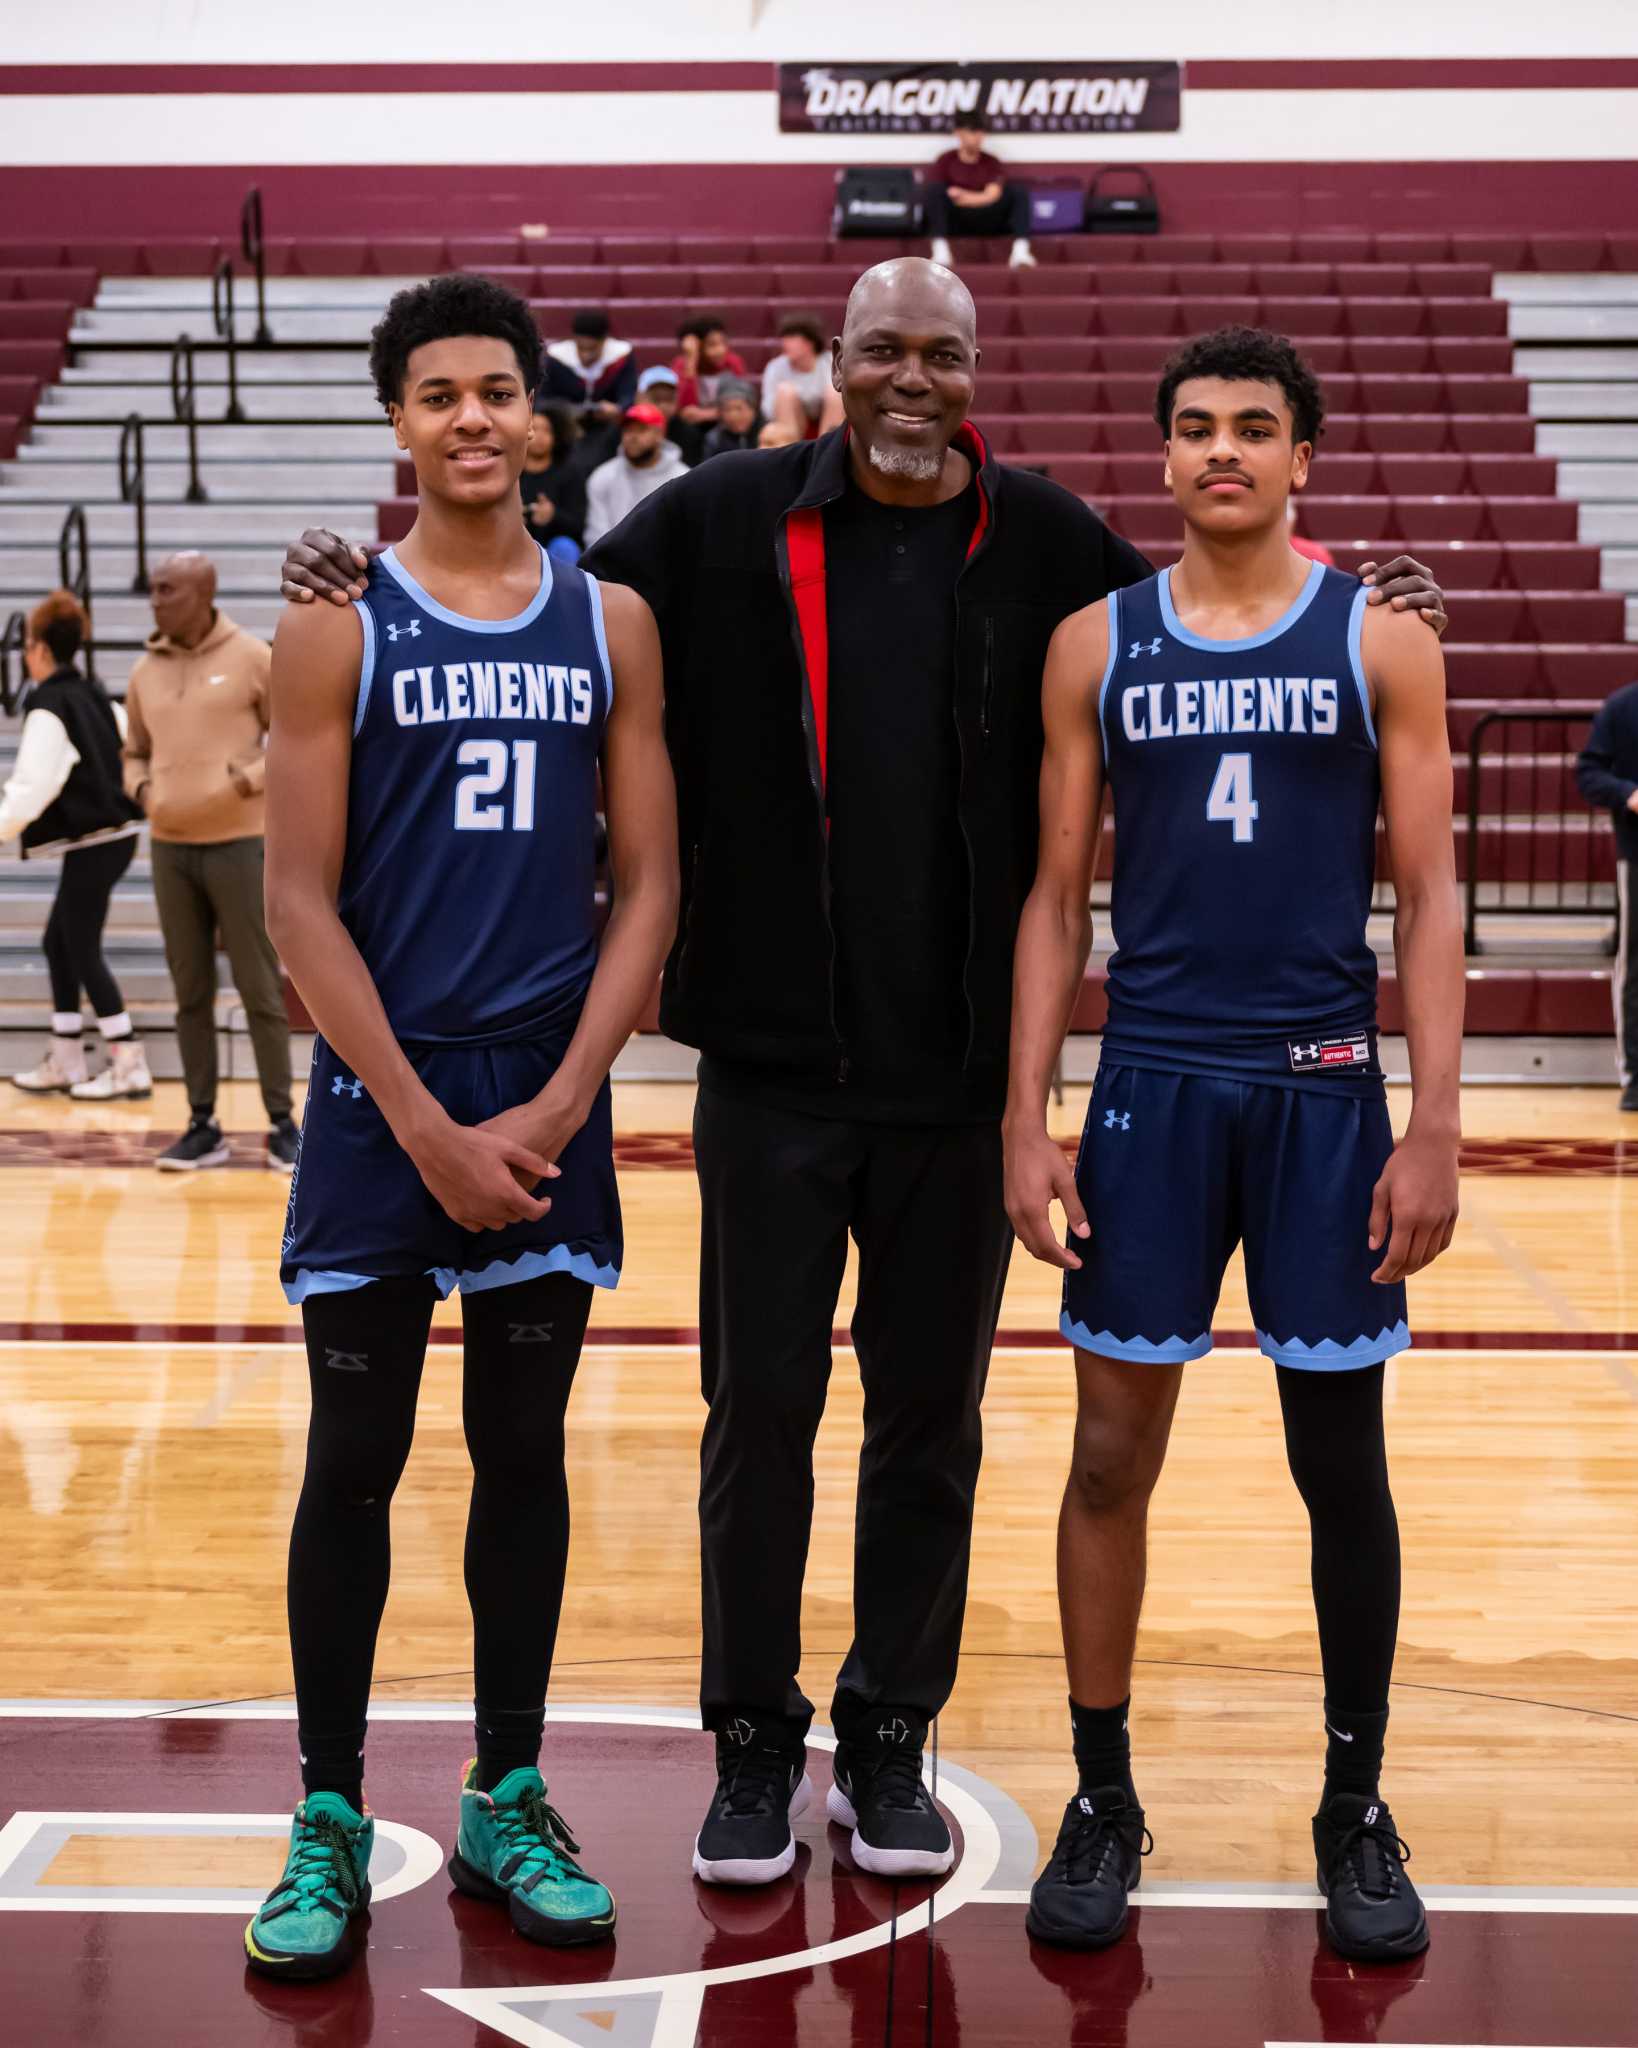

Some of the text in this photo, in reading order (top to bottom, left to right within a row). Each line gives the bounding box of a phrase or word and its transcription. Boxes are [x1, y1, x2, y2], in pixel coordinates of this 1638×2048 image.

[805, 77, 1149, 116] DRAGON NATION
[392, 661, 593, 727] CLEMENTS
[1121, 677, 1338, 742] CLEMENTS
[454, 739, 537, 831] 21
[1206, 752, 1259, 843] 4
